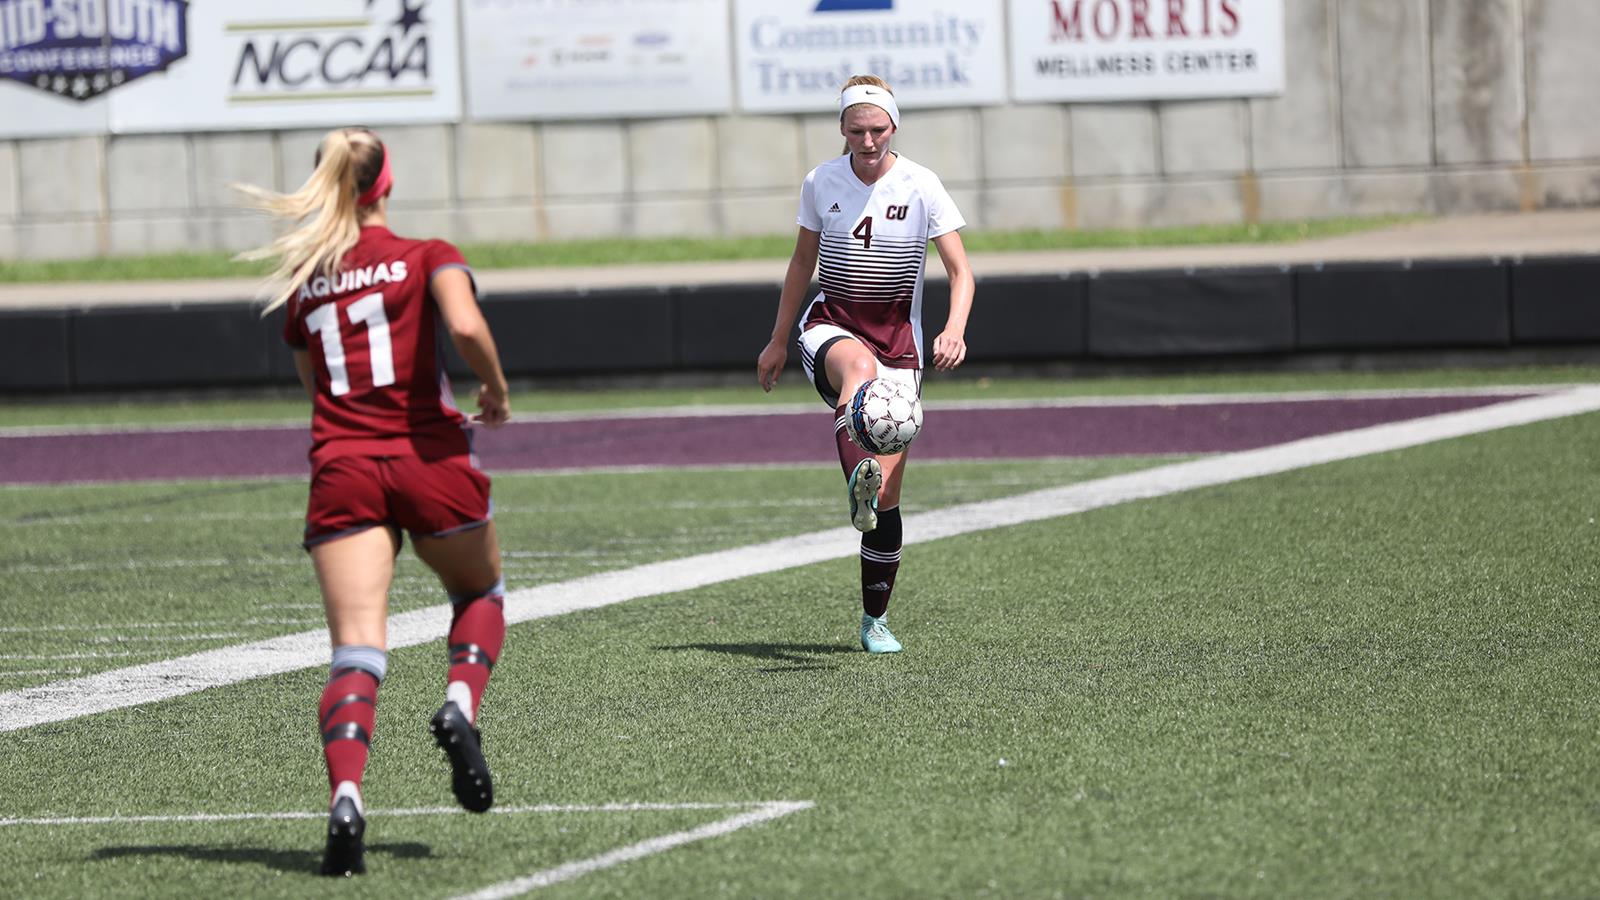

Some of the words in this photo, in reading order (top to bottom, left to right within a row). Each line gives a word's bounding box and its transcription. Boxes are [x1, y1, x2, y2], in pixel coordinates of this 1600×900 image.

[752, 13, 981, 55] Community
[1050, 0, 1241, 42] MORRIS
[0, 45, 160, 72] CONFERENCE
[233, 35, 429, 86] NCCAA
[754, 60, 855, 92] Trust
[868, 55, 970, 88] Bank
[1036, 56, 1153, 77] WELLNESS
[1167, 51, 1257, 74] CENTER
[886, 205, 909, 220] CU
[852, 216, 873, 249] 4
[299, 260, 407, 300] AQUINAS
[305, 292, 395, 397] 11
